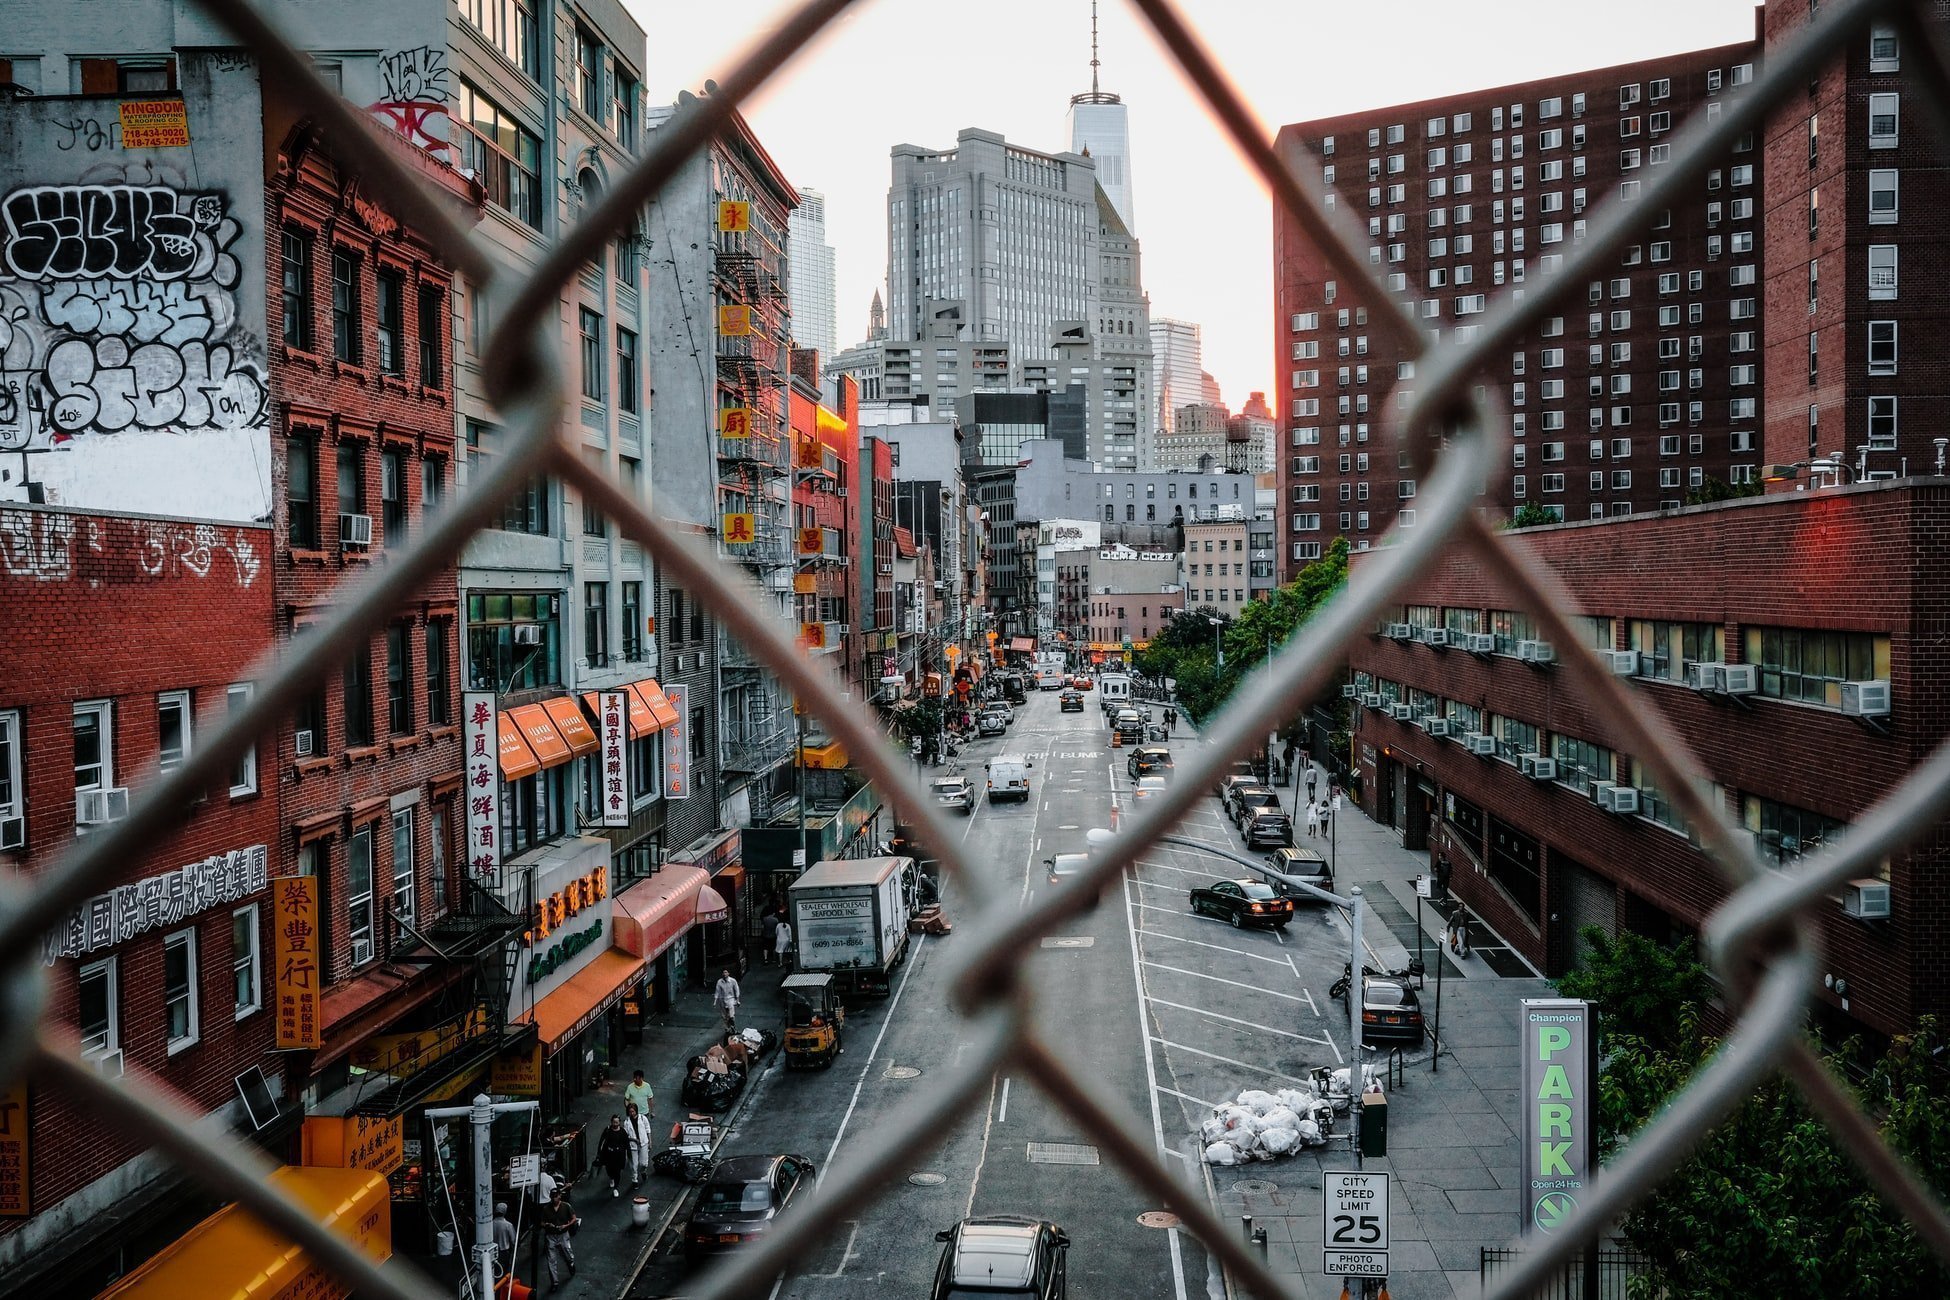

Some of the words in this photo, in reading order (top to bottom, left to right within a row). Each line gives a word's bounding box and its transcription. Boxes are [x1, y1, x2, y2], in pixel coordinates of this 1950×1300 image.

[122, 102, 183, 114] KINGDOM
[124, 128, 184, 138] 718-434-0020
[1256, 548, 1266, 558] 4
[800, 902, 830, 911] SEA-LECT
[831, 901, 868, 909] WHOLESALE
[280, 880, 316, 989] 榮豐行
[812, 940, 830, 949] (609)
[1528, 1013, 1582, 1024] Champion
[1537, 1026, 1576, 1176] PARK
[1342, 1178, 1368, 1186] CITY
[1531, 1180, 1554, 1190] Open
[1555, 1180, 1566, 1188] 24
[1566, 1180, 1582, 1188] Hrs.
[1336, 1190, 1374, 1198] SPEED
[1340, 1202, 1370, 1210] LIMIT
[1332, 1214, 1380, 1244] 25
[1340, 1254, 1372, 1264] PHOTO
[1329, 1264, 1382, 1272] ENFORCED
